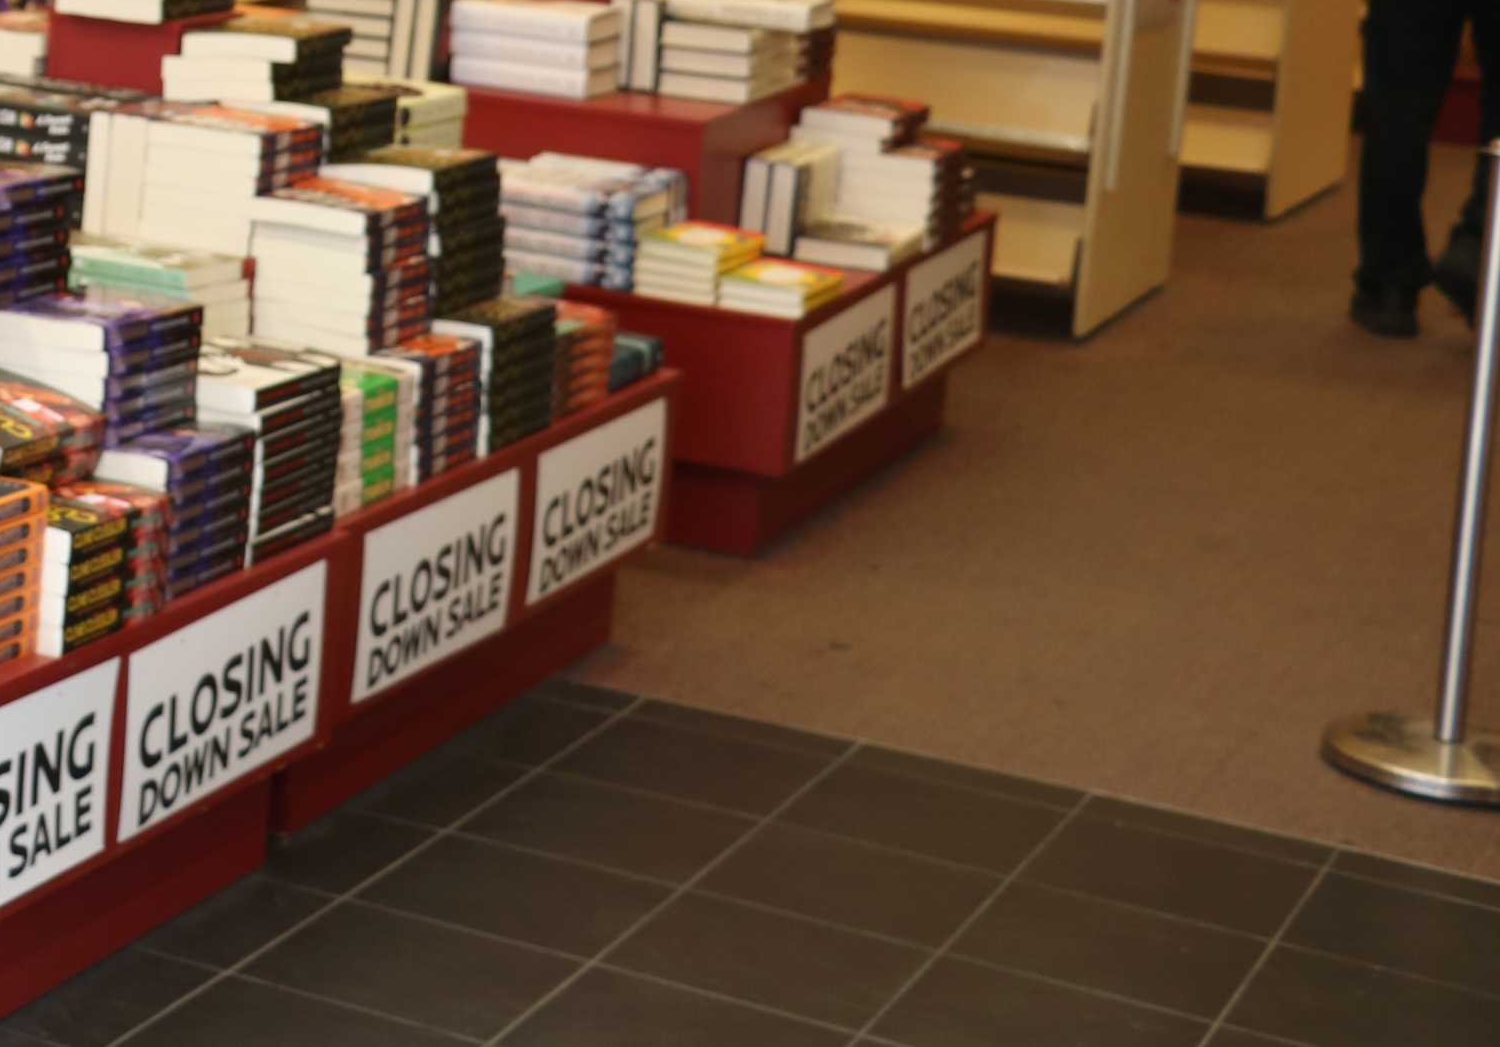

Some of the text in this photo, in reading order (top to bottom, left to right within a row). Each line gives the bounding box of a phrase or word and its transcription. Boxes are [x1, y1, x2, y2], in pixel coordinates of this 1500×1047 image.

[539, 491, 651, 594] DOWN SALE
[544, 438, 655, 547] CLOSING
[367, 571, 503, 689] DOWN SALE
[371, 512, 506, 636] CLOSING
[140, 611, 309, 768] CLOSING
[138, 676, 308, 826] DOWN SALE
[8, 785, 92, 879] SALE
